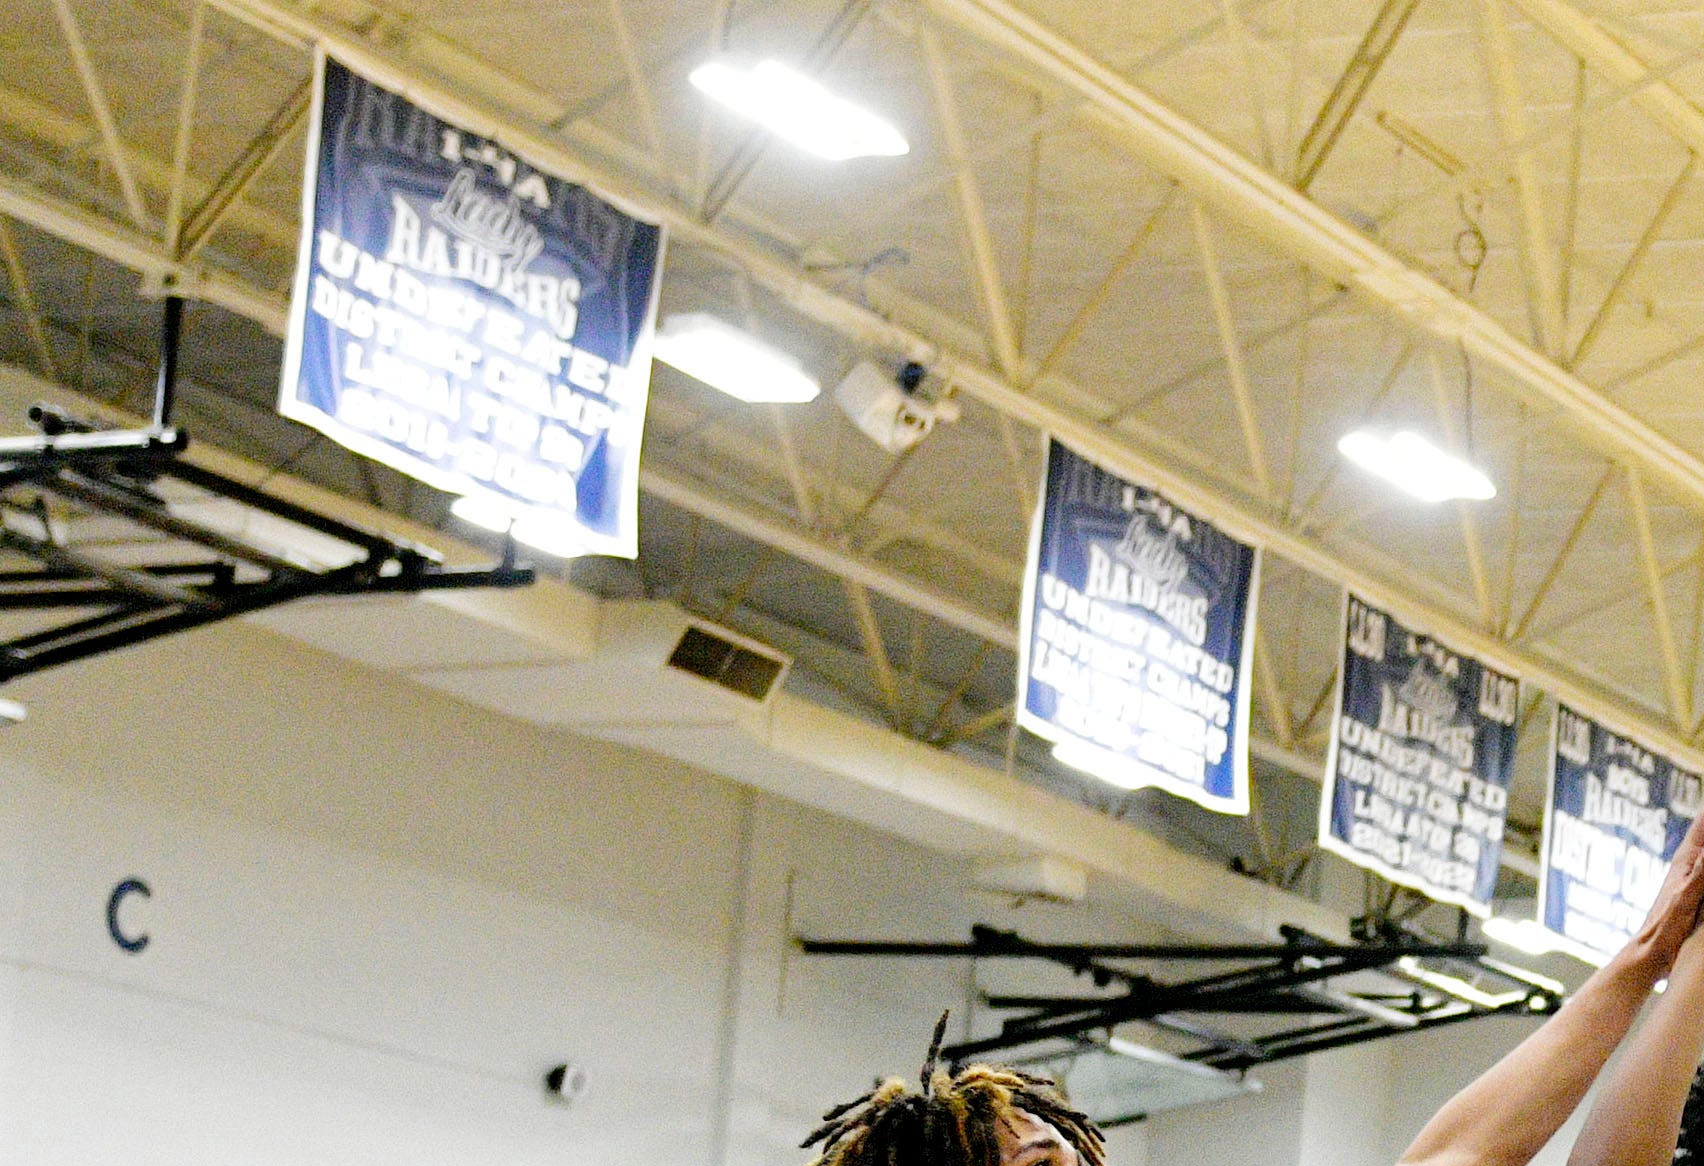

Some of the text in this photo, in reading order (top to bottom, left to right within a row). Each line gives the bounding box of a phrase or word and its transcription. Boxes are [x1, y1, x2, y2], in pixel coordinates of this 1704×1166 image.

[386, 195, 578, 343] RAIDERS
[1086, 544, 1206, 647] RAIDERS
[106, 877, 151, 953] C
